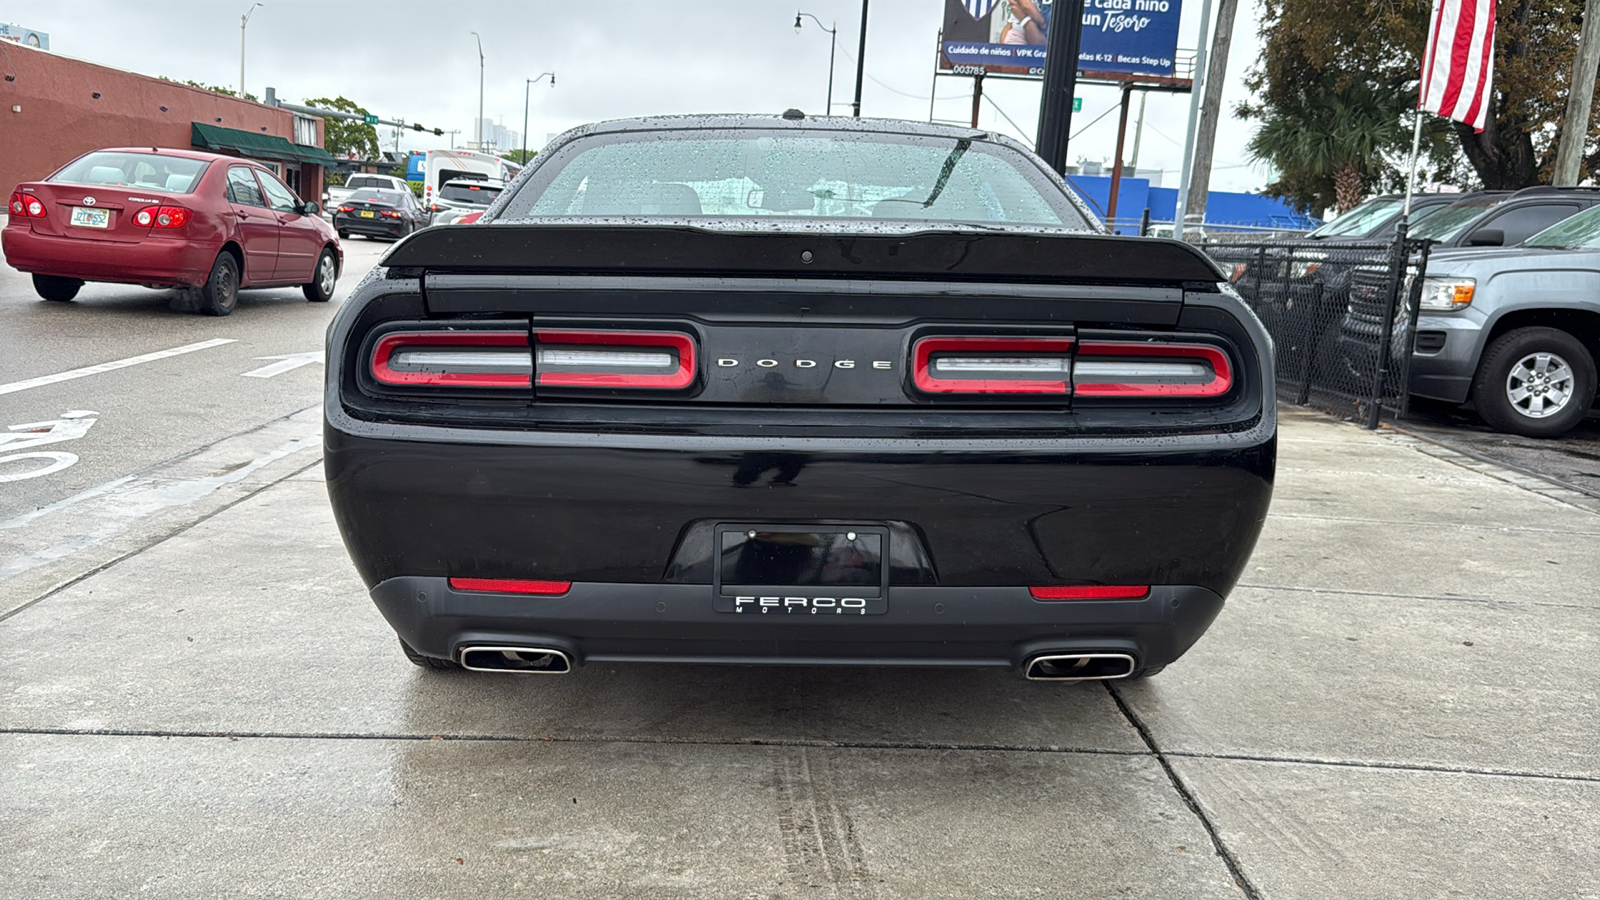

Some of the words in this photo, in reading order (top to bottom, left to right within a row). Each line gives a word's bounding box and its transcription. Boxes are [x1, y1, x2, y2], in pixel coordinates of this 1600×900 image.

[1102, 10, 1151, 32] Tesoro
[948, 46, 978, 55] Cuidado
[980, 47, 990, 55] de
[990, 48, 1011, 56] niños
[1079, 52, 1094, 61] elas
[1095, 54, 1112, 62] K-12
[1117, 55, 1140, 63] Becas
[1141, 56, 1159, 67] Step
[1160, 59, 1171, 67] Up
[953, 65, 985, 75] 003785
[718, 358, 892, 370] DODGE
[735, 596, 866, 608] FERCO
[735, 607, 866, 615] MOTORS
